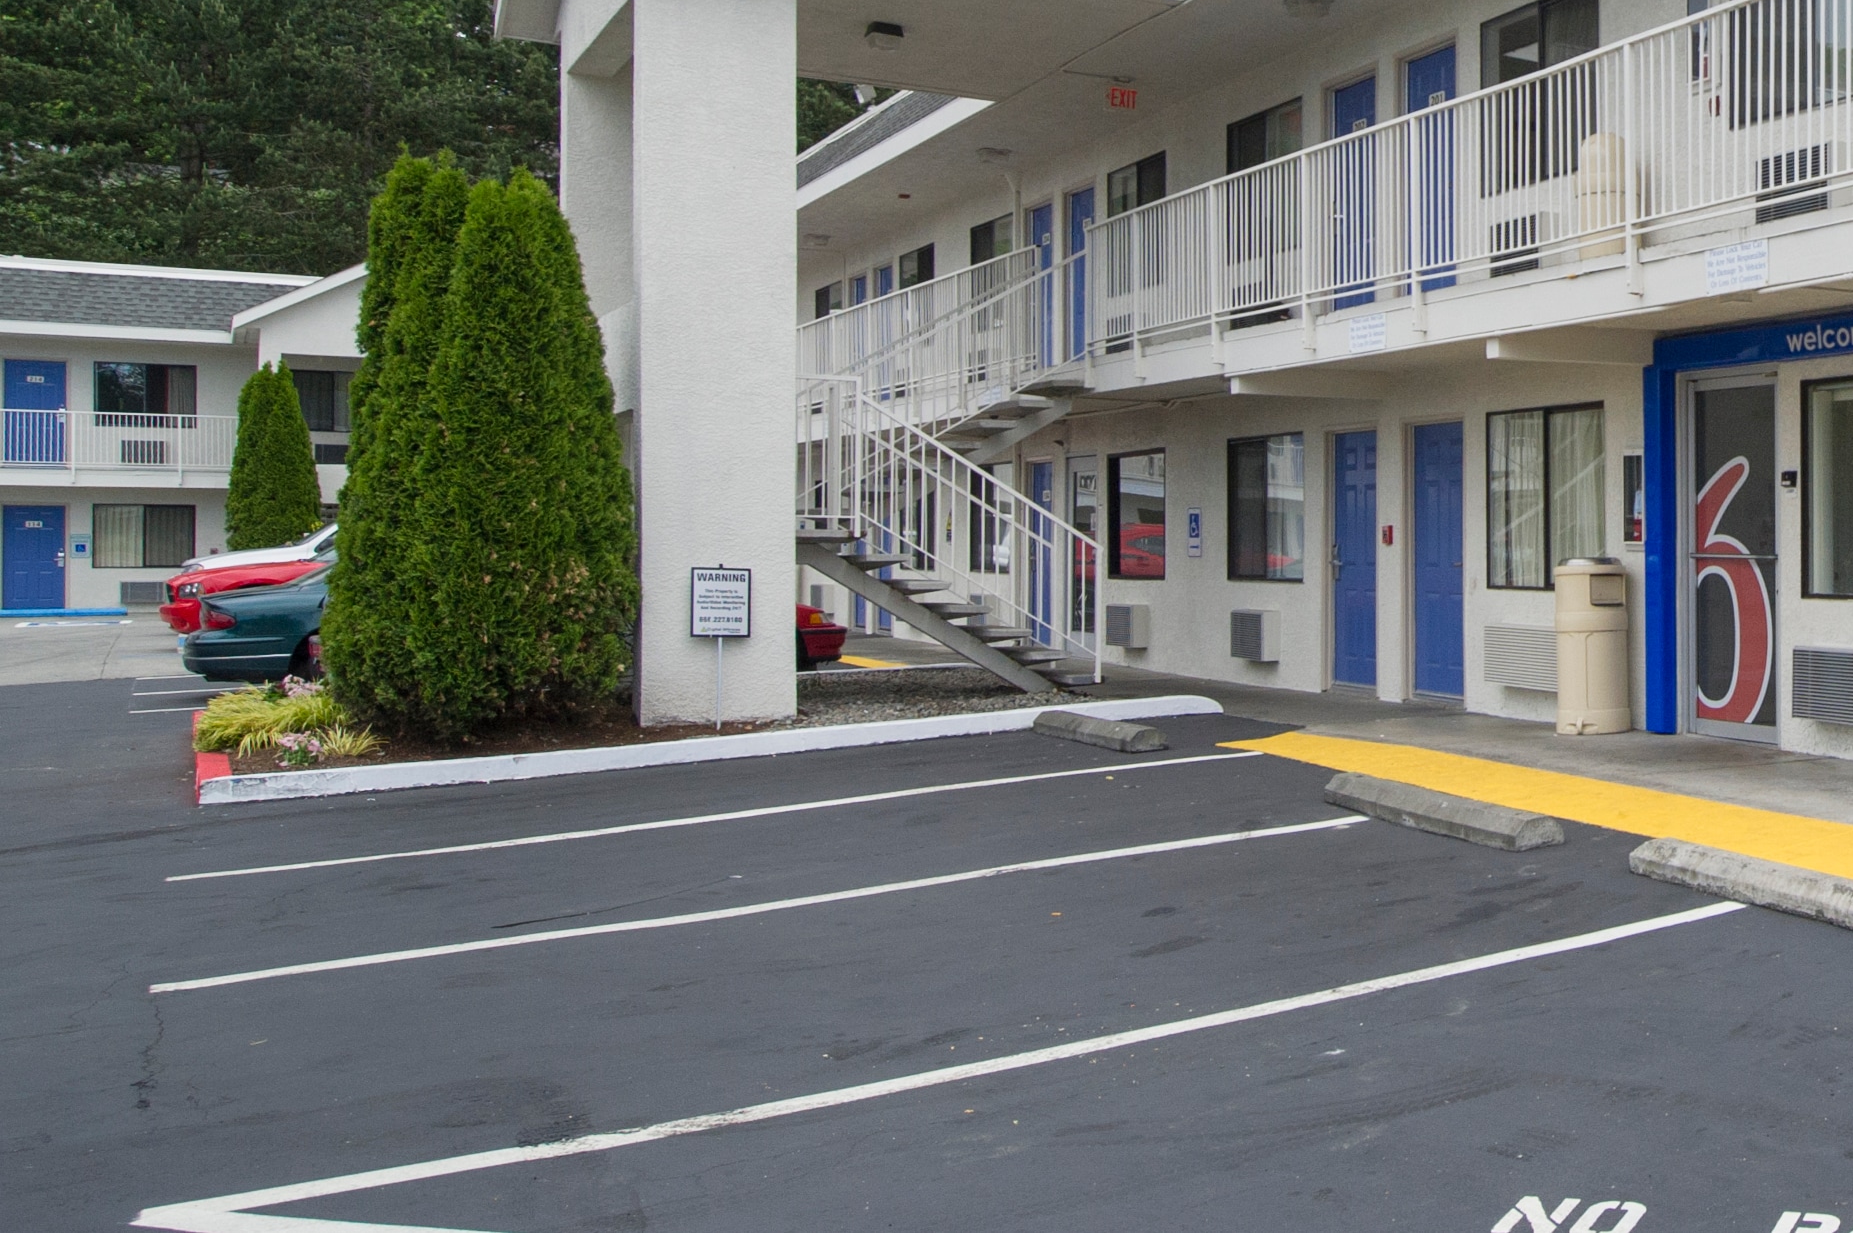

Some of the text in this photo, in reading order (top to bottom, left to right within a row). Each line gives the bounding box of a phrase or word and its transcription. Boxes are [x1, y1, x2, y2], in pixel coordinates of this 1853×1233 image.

[1110, 87, 1138, 110] EXIT
[1430, 93, 1444, 107] 201
[697, 573, 746, 583] WARNING
[1696, 455, 1773, 724] 6
[1490, 1195, 1648, 1233] NO
